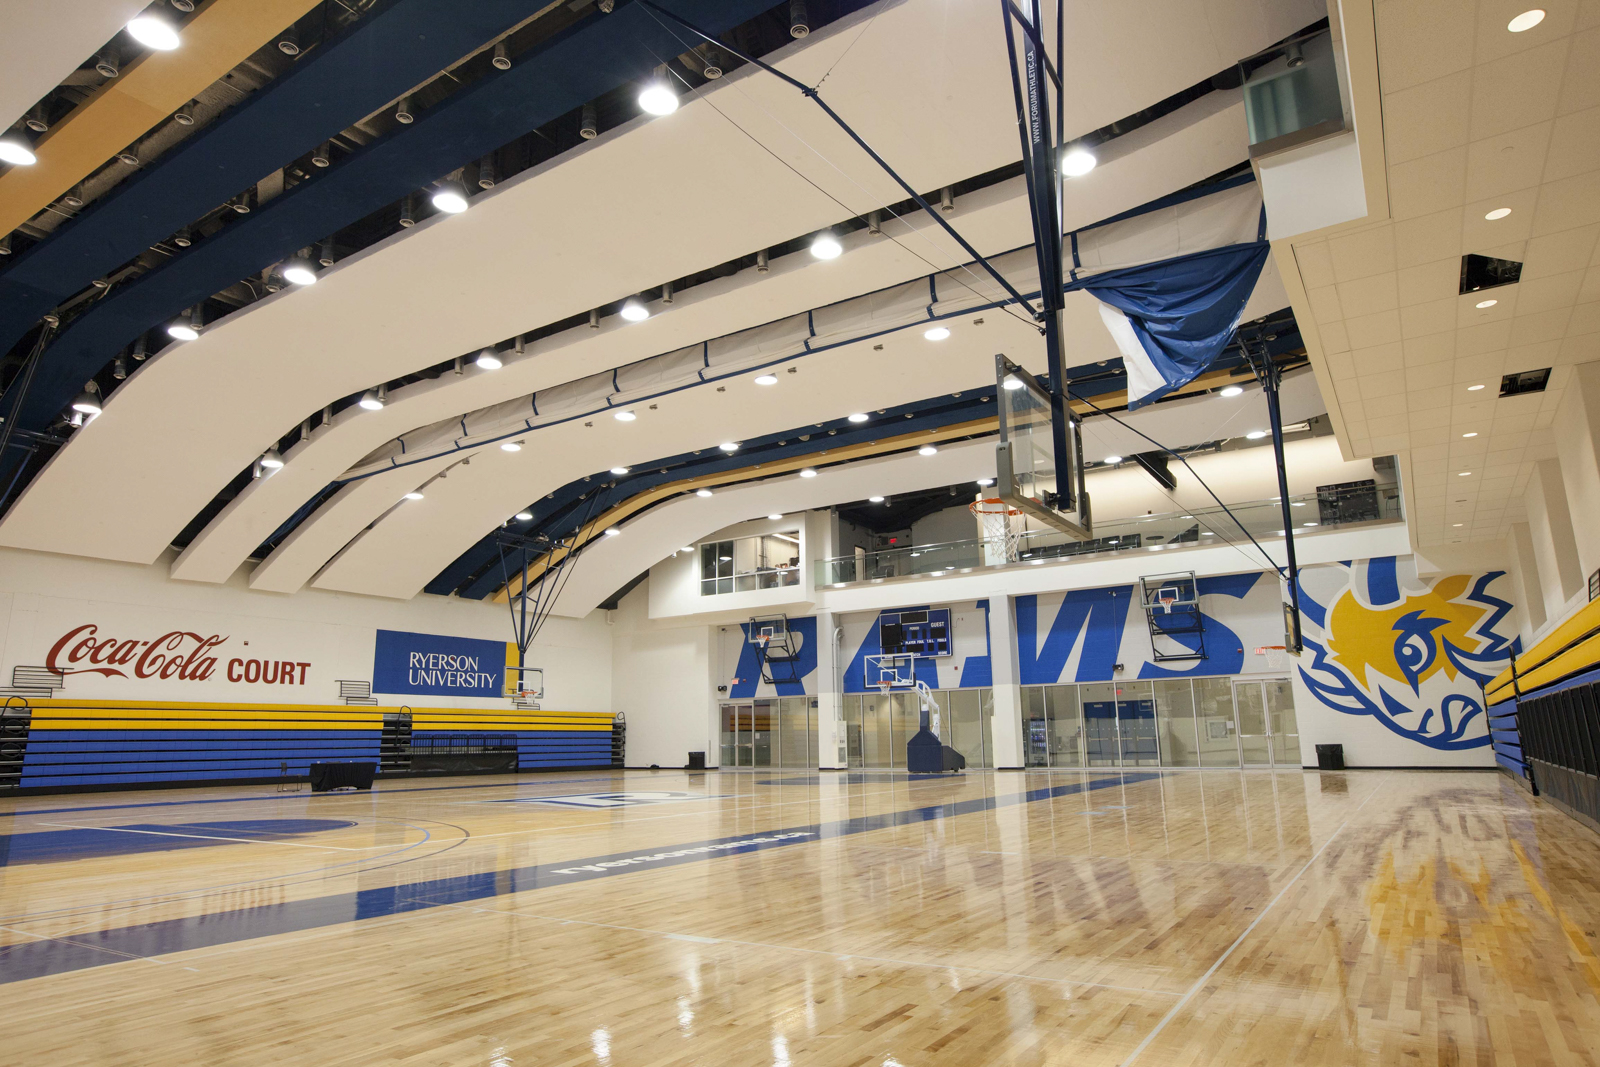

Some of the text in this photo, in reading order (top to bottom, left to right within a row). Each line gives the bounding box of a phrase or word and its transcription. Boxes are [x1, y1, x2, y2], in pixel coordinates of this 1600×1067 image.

[46, 624, 311, 685] Coca-Cola COURT
[729, 571, 1264, 699] RAMS
[409, 651, 479, 672] RYERSON
[409, 669, 497, 689] UNIVERSITY
[550, 832, 816, 872] ryersonrams.ca
